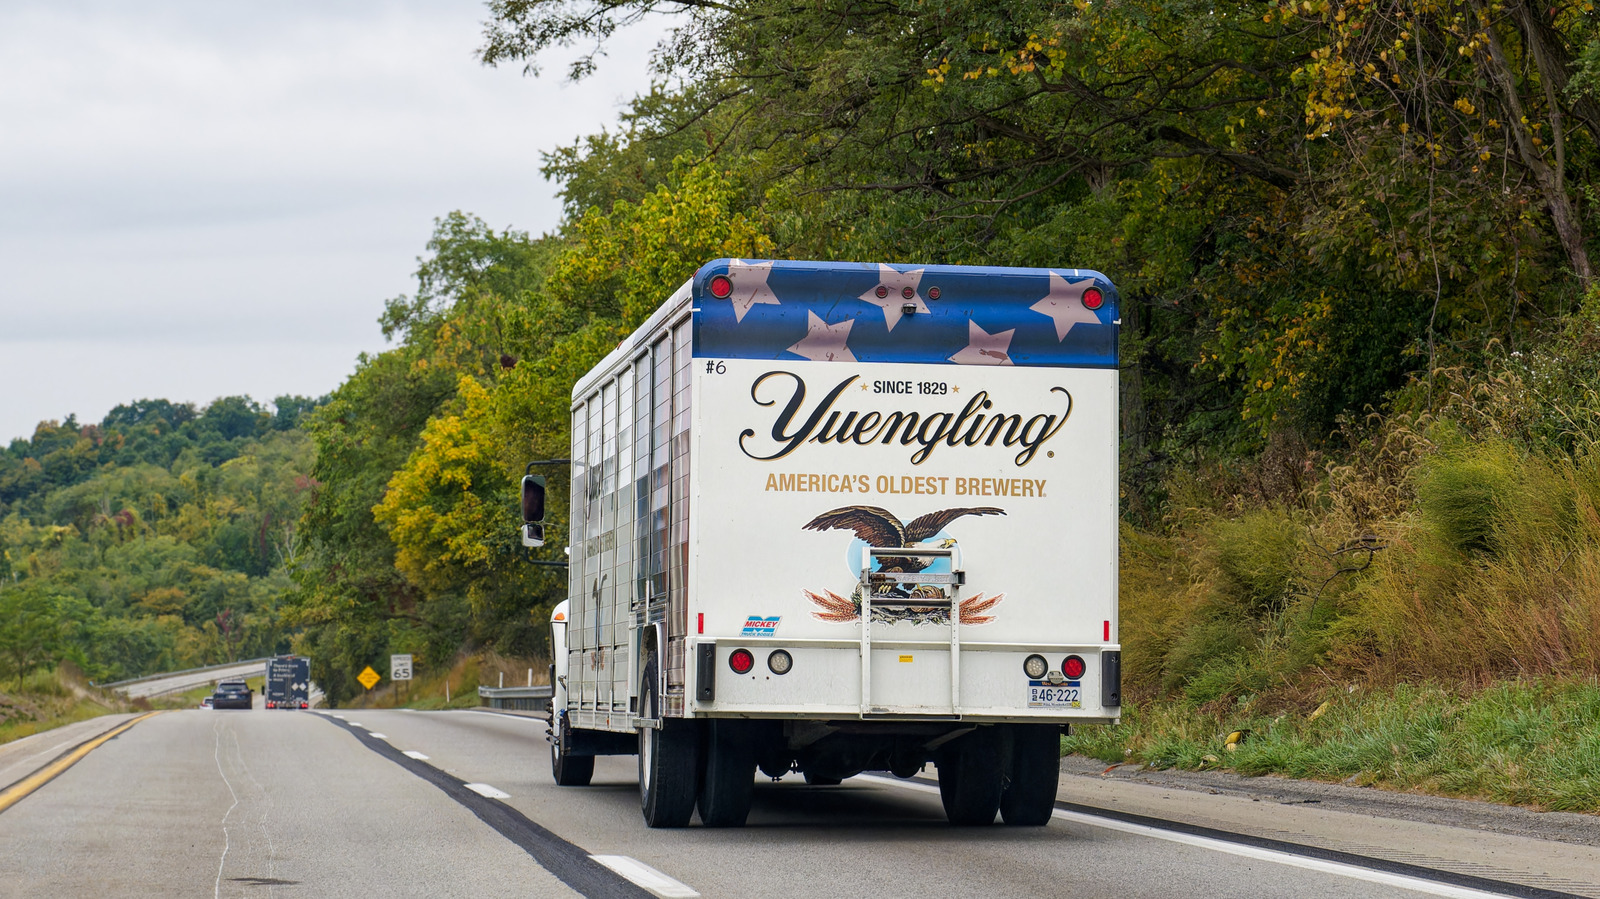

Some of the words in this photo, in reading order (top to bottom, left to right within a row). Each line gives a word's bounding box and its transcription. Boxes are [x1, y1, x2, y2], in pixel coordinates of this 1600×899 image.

[706, 360, 726, 374] #6
[873, 380, 912, 394] SINCE
[917, 382, 948, 395] 1829
[739, 370, 1073, 467] Yuengling
[765, 473, 870, 493] AMERICA'S
[876, 476, 949, 495] OLDEST
[394, 668, 410, 678] 65
[1039, 689, 1078, 702] 46-222
